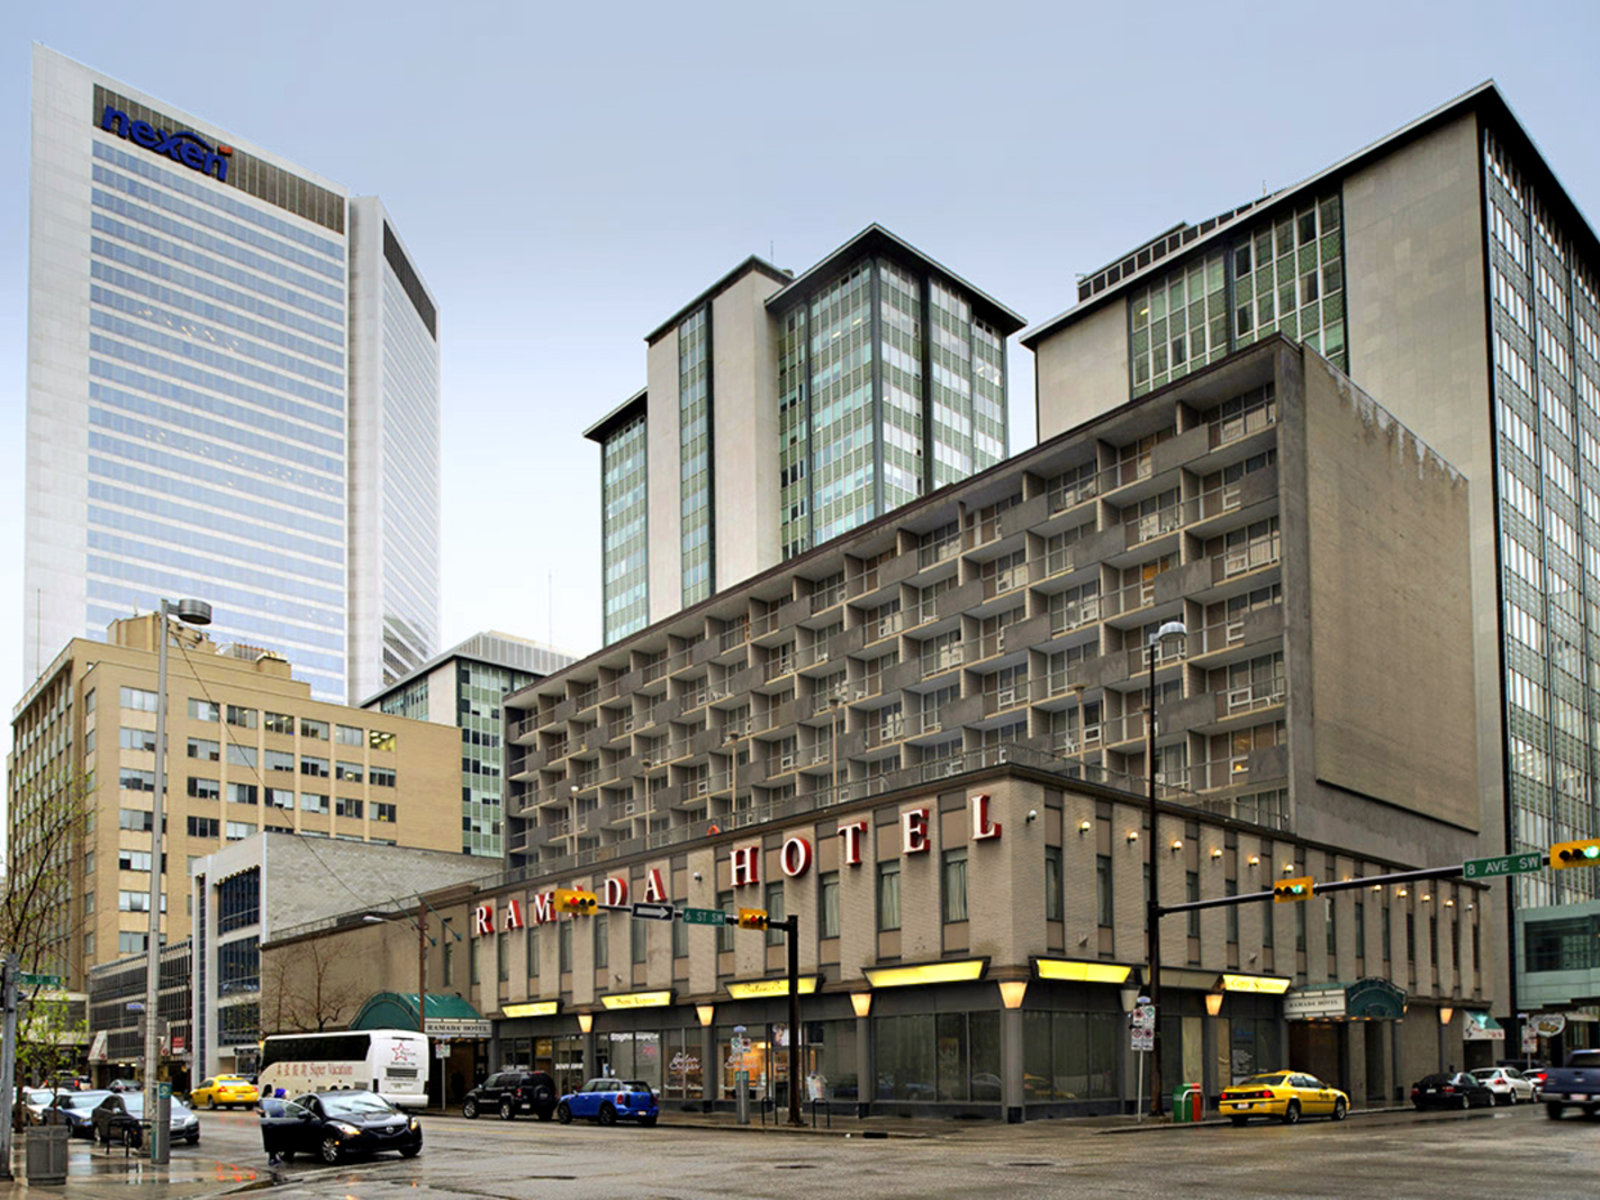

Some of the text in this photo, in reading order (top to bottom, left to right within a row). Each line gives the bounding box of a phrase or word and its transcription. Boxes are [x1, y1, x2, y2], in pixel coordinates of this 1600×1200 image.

[101, 104, 229, 182] nexen
[475, 795, 1001, 936] RAMDA HOTEL
[1467, 856, 1539, 876] 8 AVE SW
[685, 911, 692, 921] 6
[697, 911, 707, 922] ST
[328, 1061, 353, 1075] Vacation
